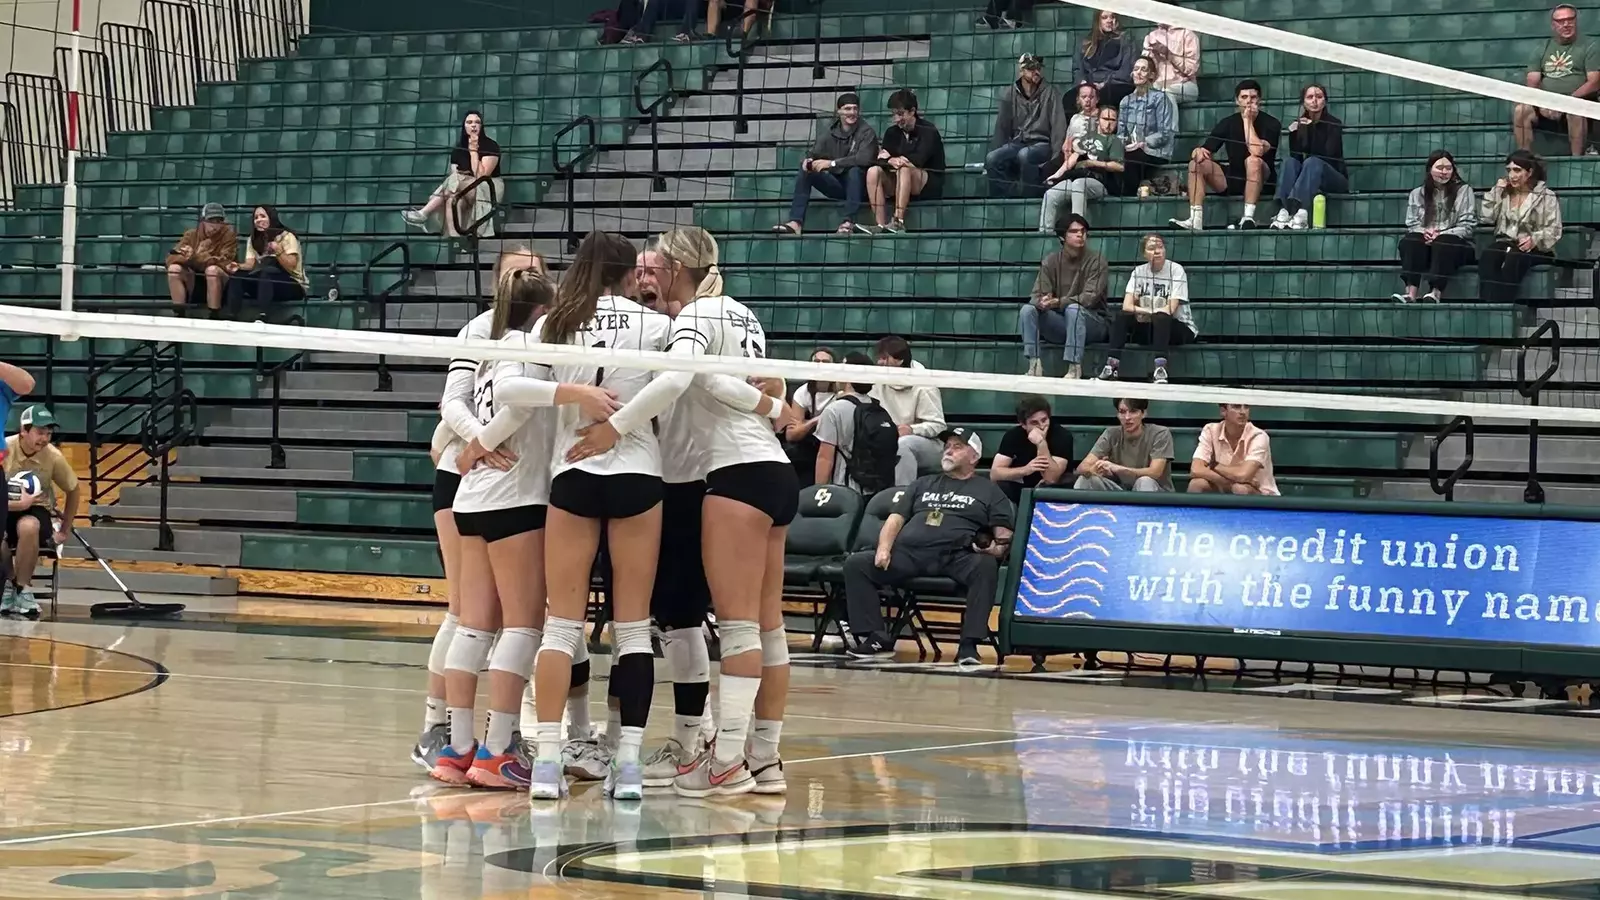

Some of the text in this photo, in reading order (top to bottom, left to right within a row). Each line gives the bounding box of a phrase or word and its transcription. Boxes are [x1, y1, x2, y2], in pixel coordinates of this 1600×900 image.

[1136, 521, 1520, 572] The credit union
[1127, 567, 1223, 605] with
[1240, 571, 1312, 609] the
[1324, 575, 1470, 626] funny
